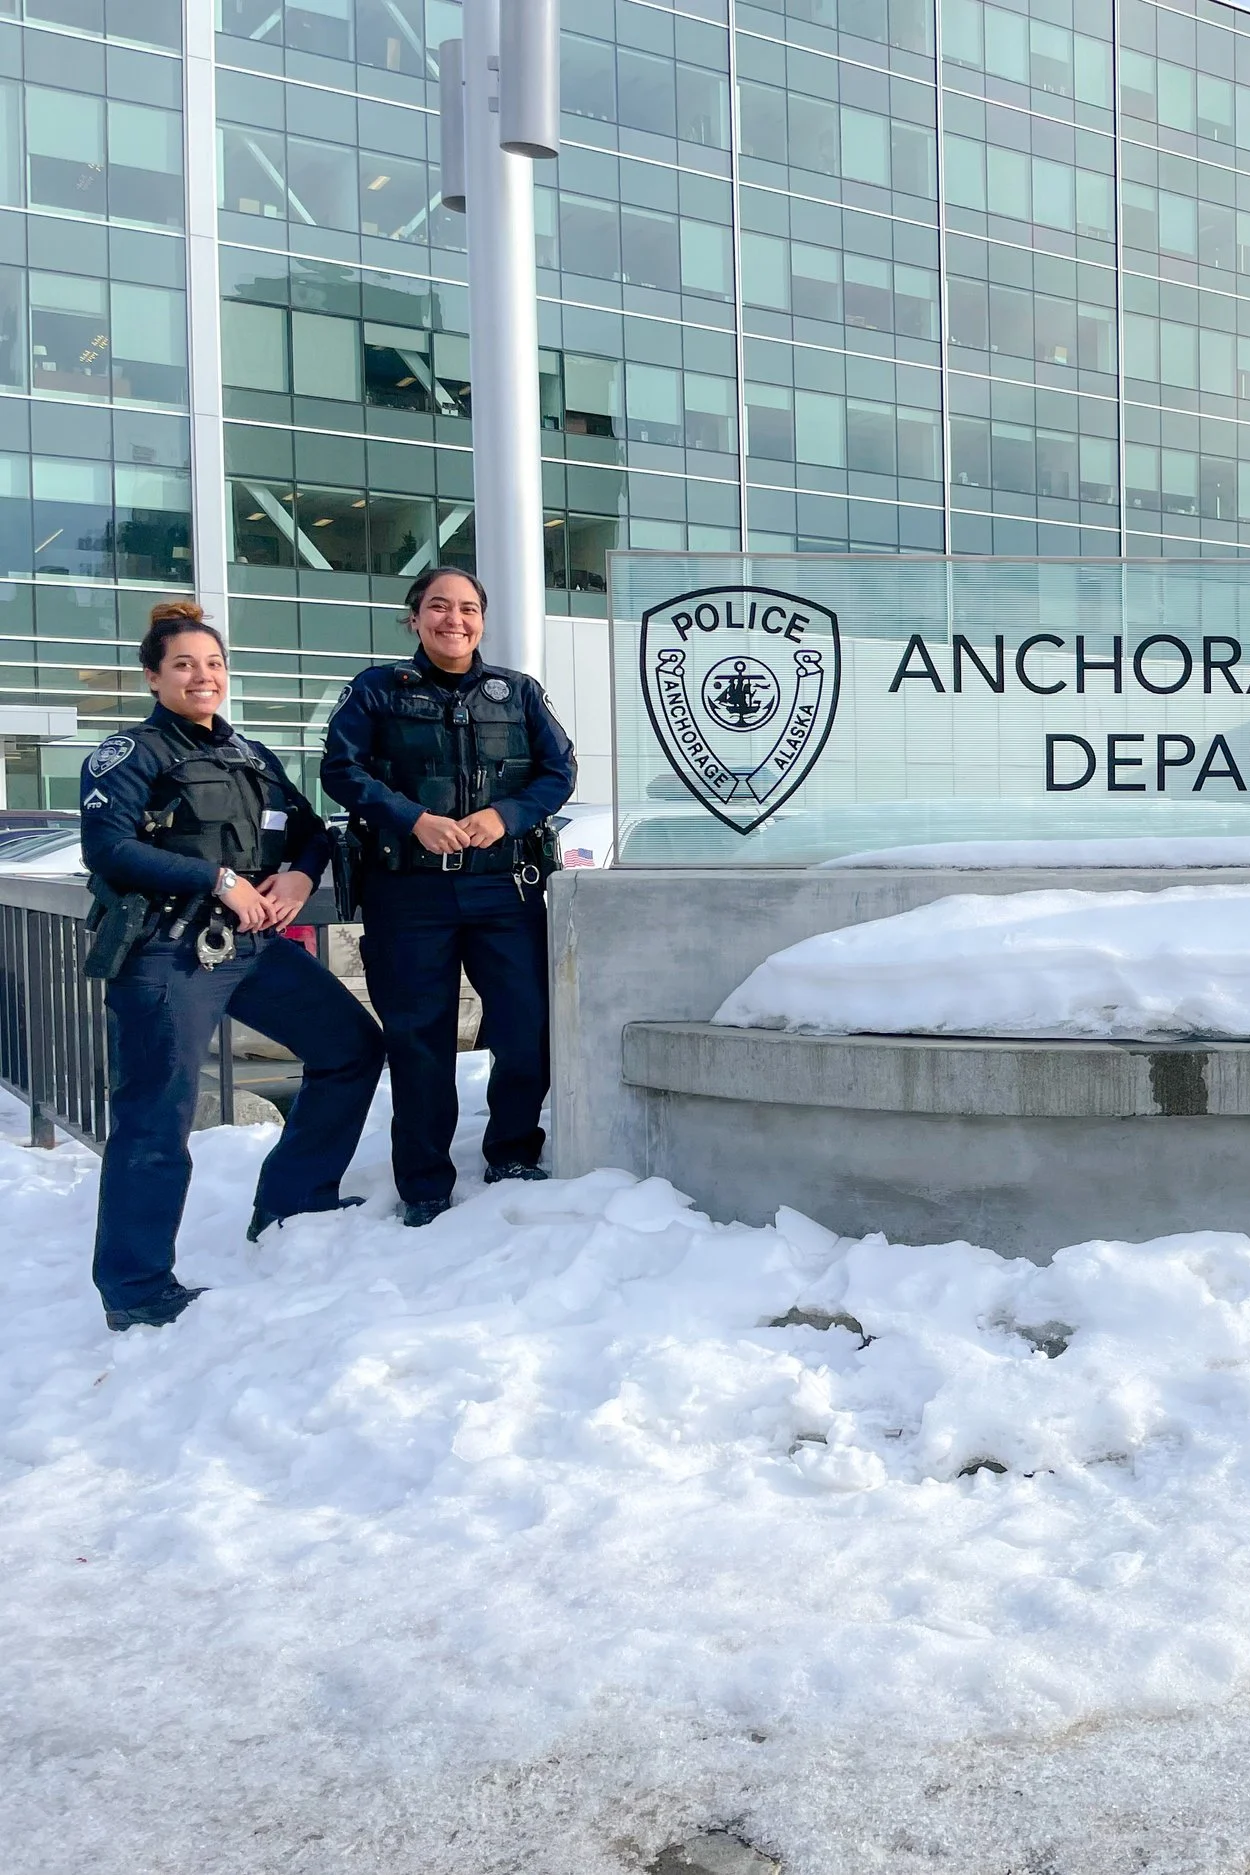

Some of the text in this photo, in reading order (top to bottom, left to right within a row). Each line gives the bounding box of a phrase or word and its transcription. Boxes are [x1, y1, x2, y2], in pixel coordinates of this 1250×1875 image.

[671, 602, 810, 643] POLICE
[664, 680, 729, 788] ANCHORAGE
[774, 705, 814, 770] ALASKA
